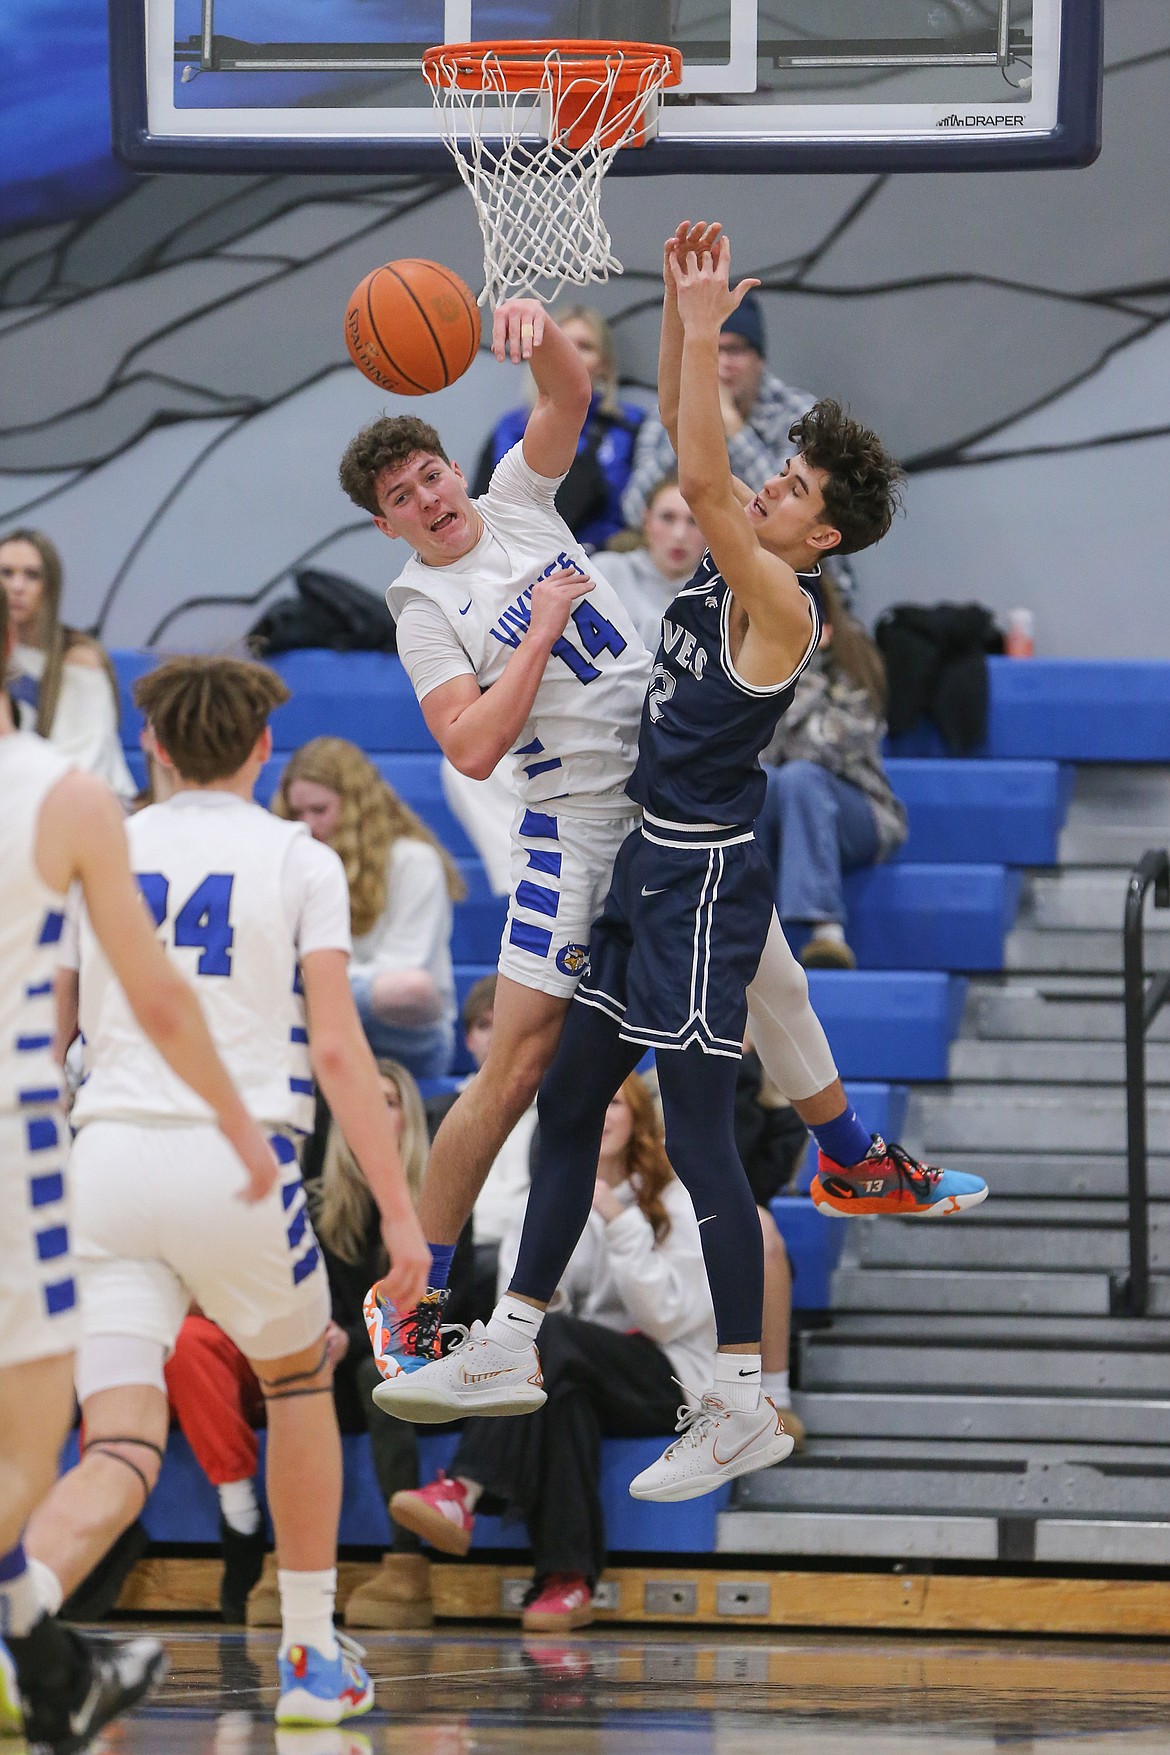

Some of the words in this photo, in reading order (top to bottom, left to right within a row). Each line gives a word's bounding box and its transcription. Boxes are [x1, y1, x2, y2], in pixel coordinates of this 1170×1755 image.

[965, 115, 1024, 126] DRAPER
[348, 307, 400, 391] SPALDING
[488, 551, 585, 650] VIKS
[551, 599, 627, 686] 14
[865, 1179, 884, 1193] 13
